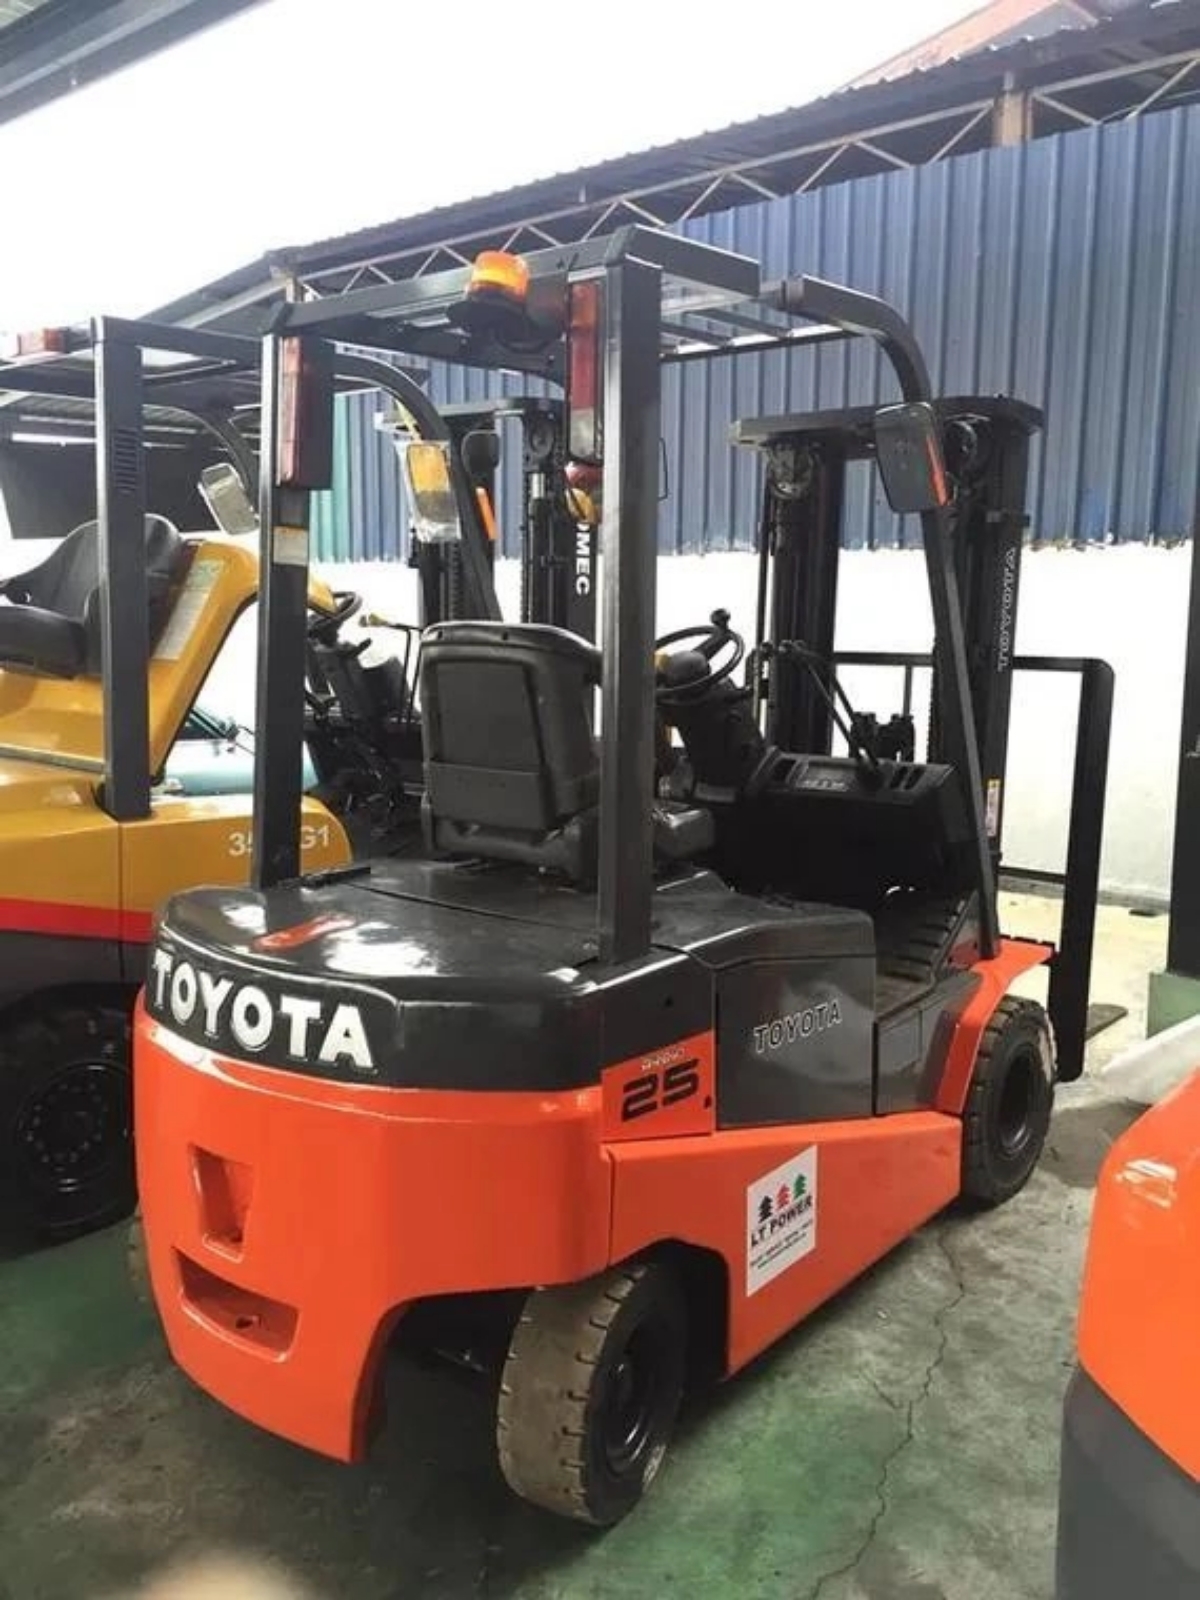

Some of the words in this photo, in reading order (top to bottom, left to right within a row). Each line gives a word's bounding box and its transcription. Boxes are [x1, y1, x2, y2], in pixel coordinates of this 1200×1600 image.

[152, 948, 377, 1071] TOYOTA
[753, 999, 842, 1053] TOYOTA
[622, 1058, 700, 1122] 25
[750, 1226, 768, 1248] LT
[770, 1194, 813, 1234] POWER
